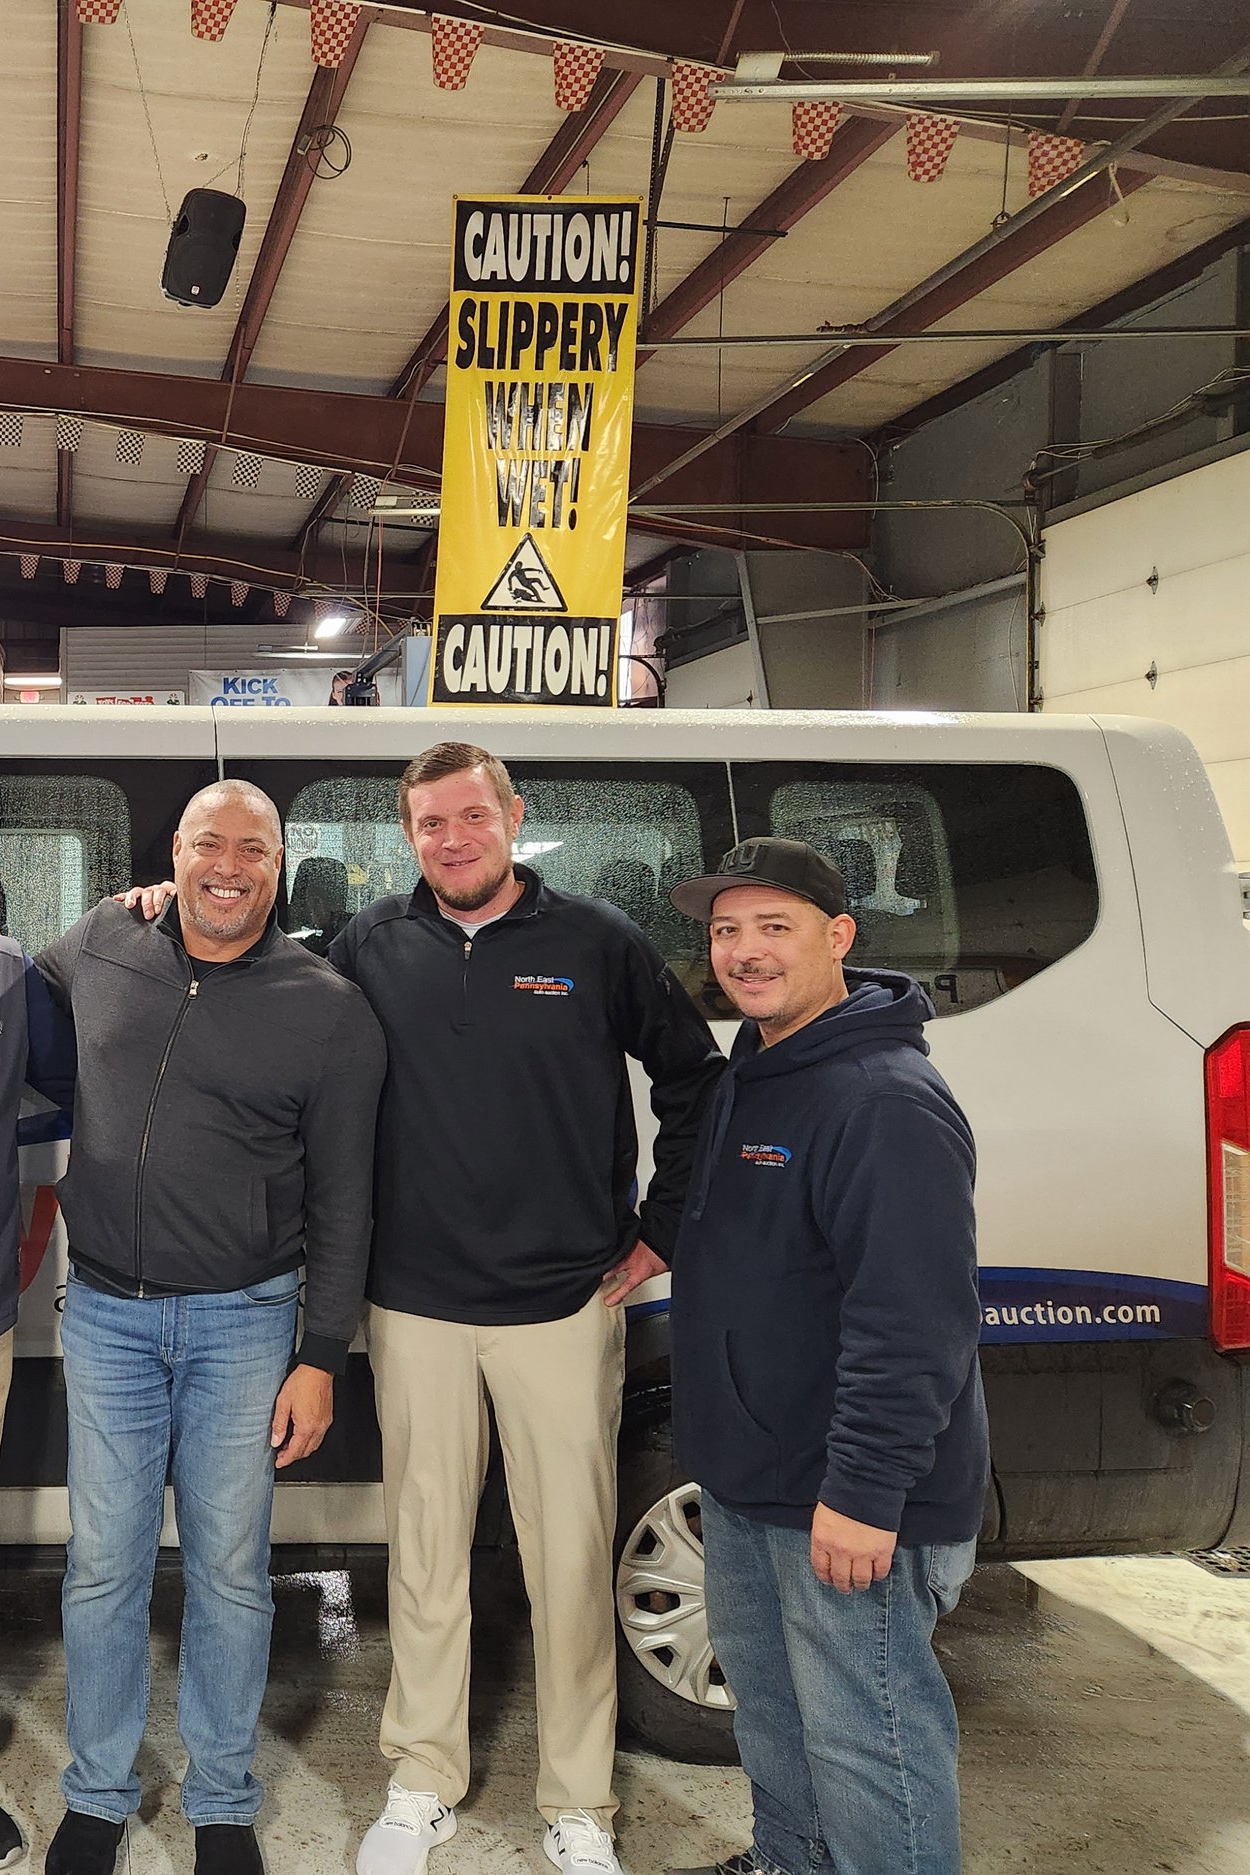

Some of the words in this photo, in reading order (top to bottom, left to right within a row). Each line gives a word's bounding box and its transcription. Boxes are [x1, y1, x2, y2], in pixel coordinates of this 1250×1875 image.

[464, 210, 632, 283] CAUTION!
[454, 297, 629, 372] SLIPPERY
[484, 380, 594, 452] WHEN
[495, 457, 581, 530] WET!
[223, 677, 278, 694] KICK
[442, 623, 611, 697] CAUTION!
[514, 983, 568, 992] Pennsylvania
[536, 976, 555, 984] East
[977, 1301, 1161, 1326] auction.com
